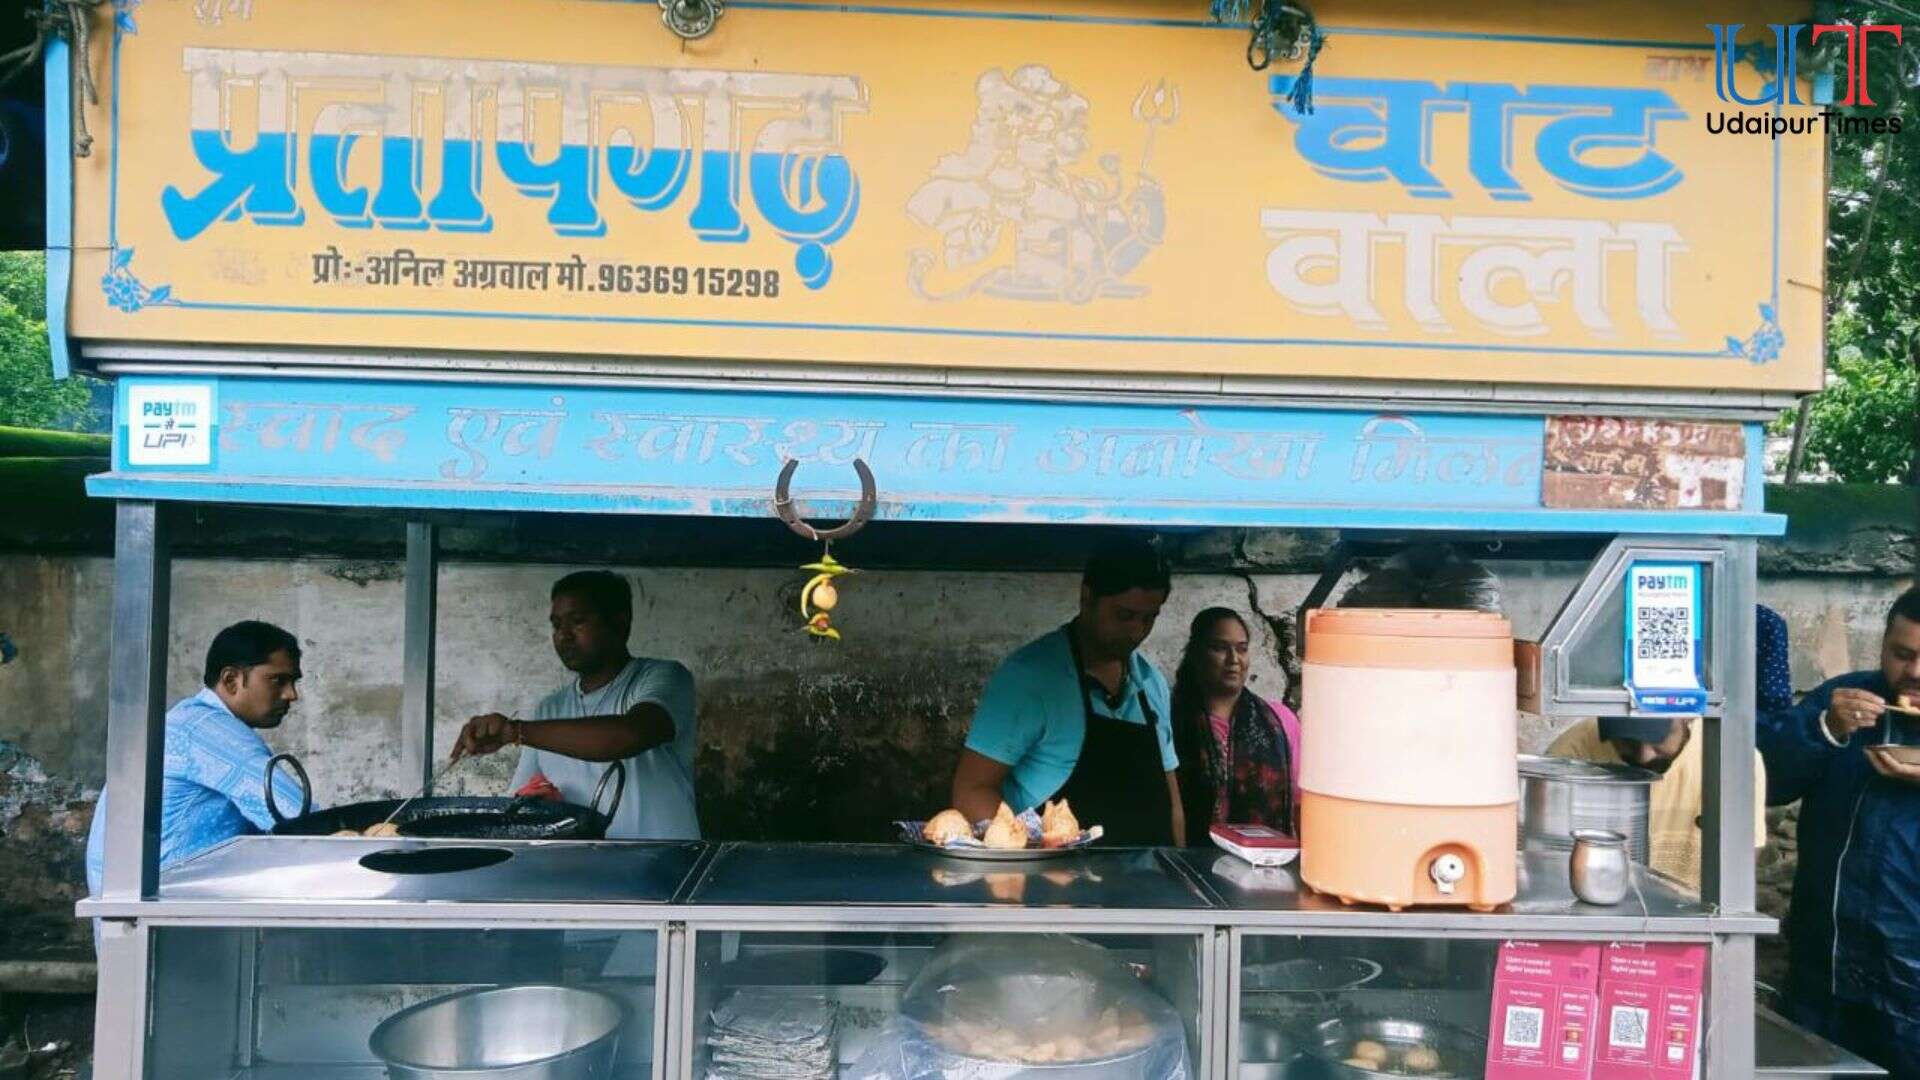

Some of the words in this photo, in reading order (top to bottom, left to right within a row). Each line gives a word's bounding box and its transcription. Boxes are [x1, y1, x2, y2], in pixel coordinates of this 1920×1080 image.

[161, 46, 873, 291] प्रतापगढ़
[1268, 74, 1690, 202] चाट
[453, 258, 551, 291] अग्रवाल
[1260, 207, 1689, 341] वाला
[143, 433, 188, 449] UPI
[217, 401, 420, 464] स्वाद
[439, 395, 569, 481] एवं
[904, 420, 1021, 473] का
[1036, 408, 1329, 480] अनोखा
